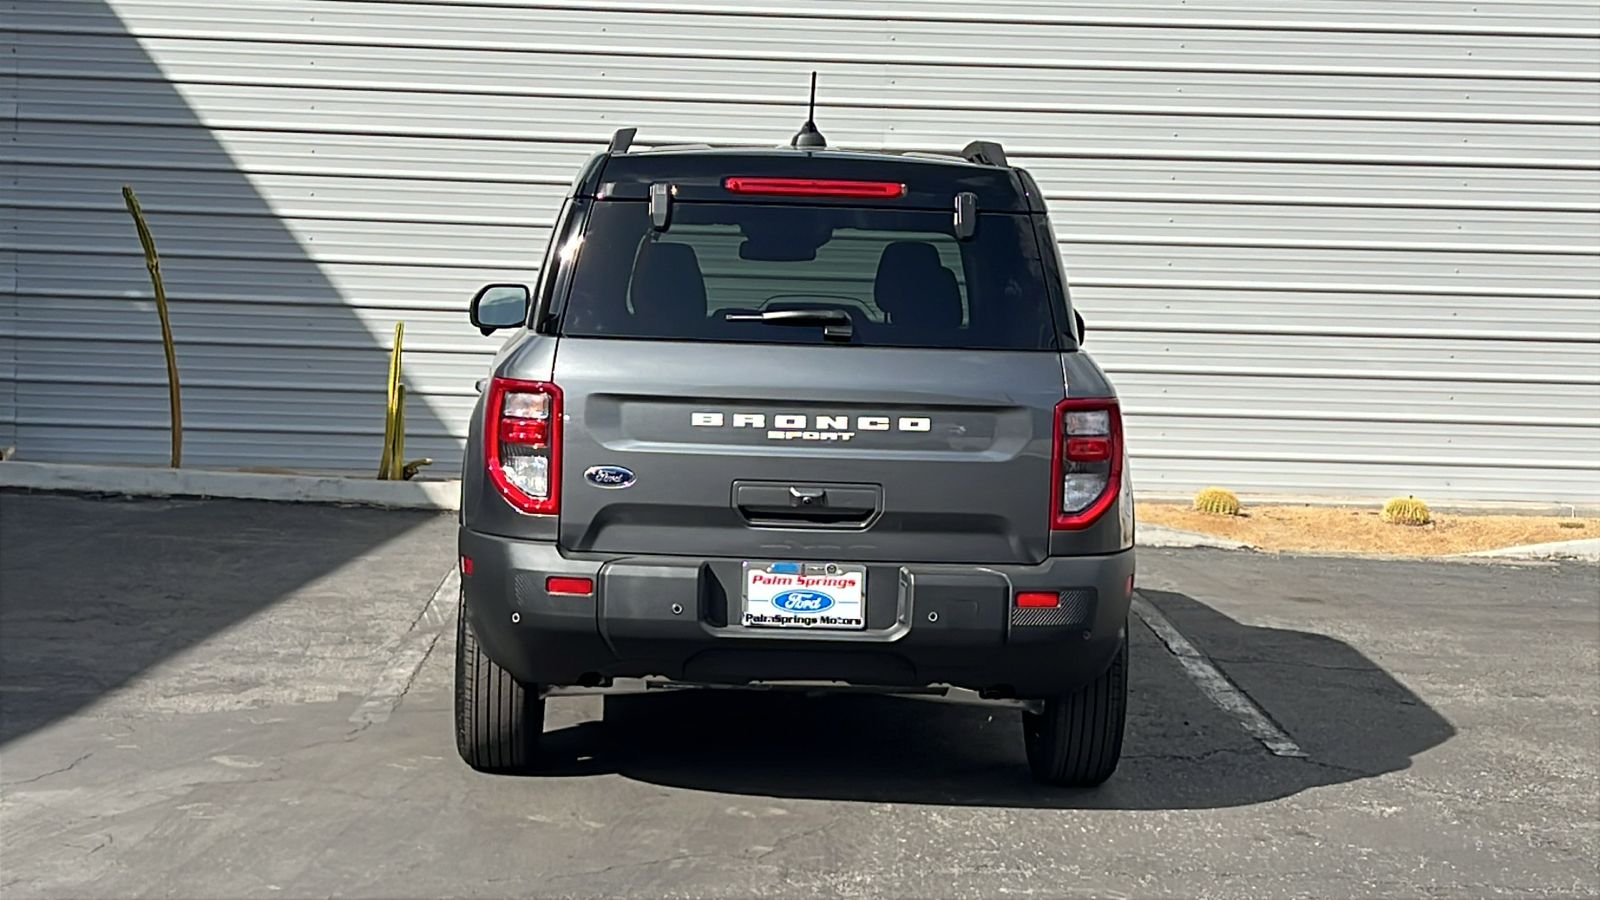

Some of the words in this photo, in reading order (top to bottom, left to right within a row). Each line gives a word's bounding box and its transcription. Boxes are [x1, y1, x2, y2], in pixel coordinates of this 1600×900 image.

[691, 412, 931, 431] BRONCO
[767, 431, 855, 441] SPORT
[595, 469, 624, 482] Ford
[752, 575, 793, 585] Palm
[796, 574, 856, 589] Springs
[784, 592, 822, 610] Ford
[819, 615, 862, 625] Motors
